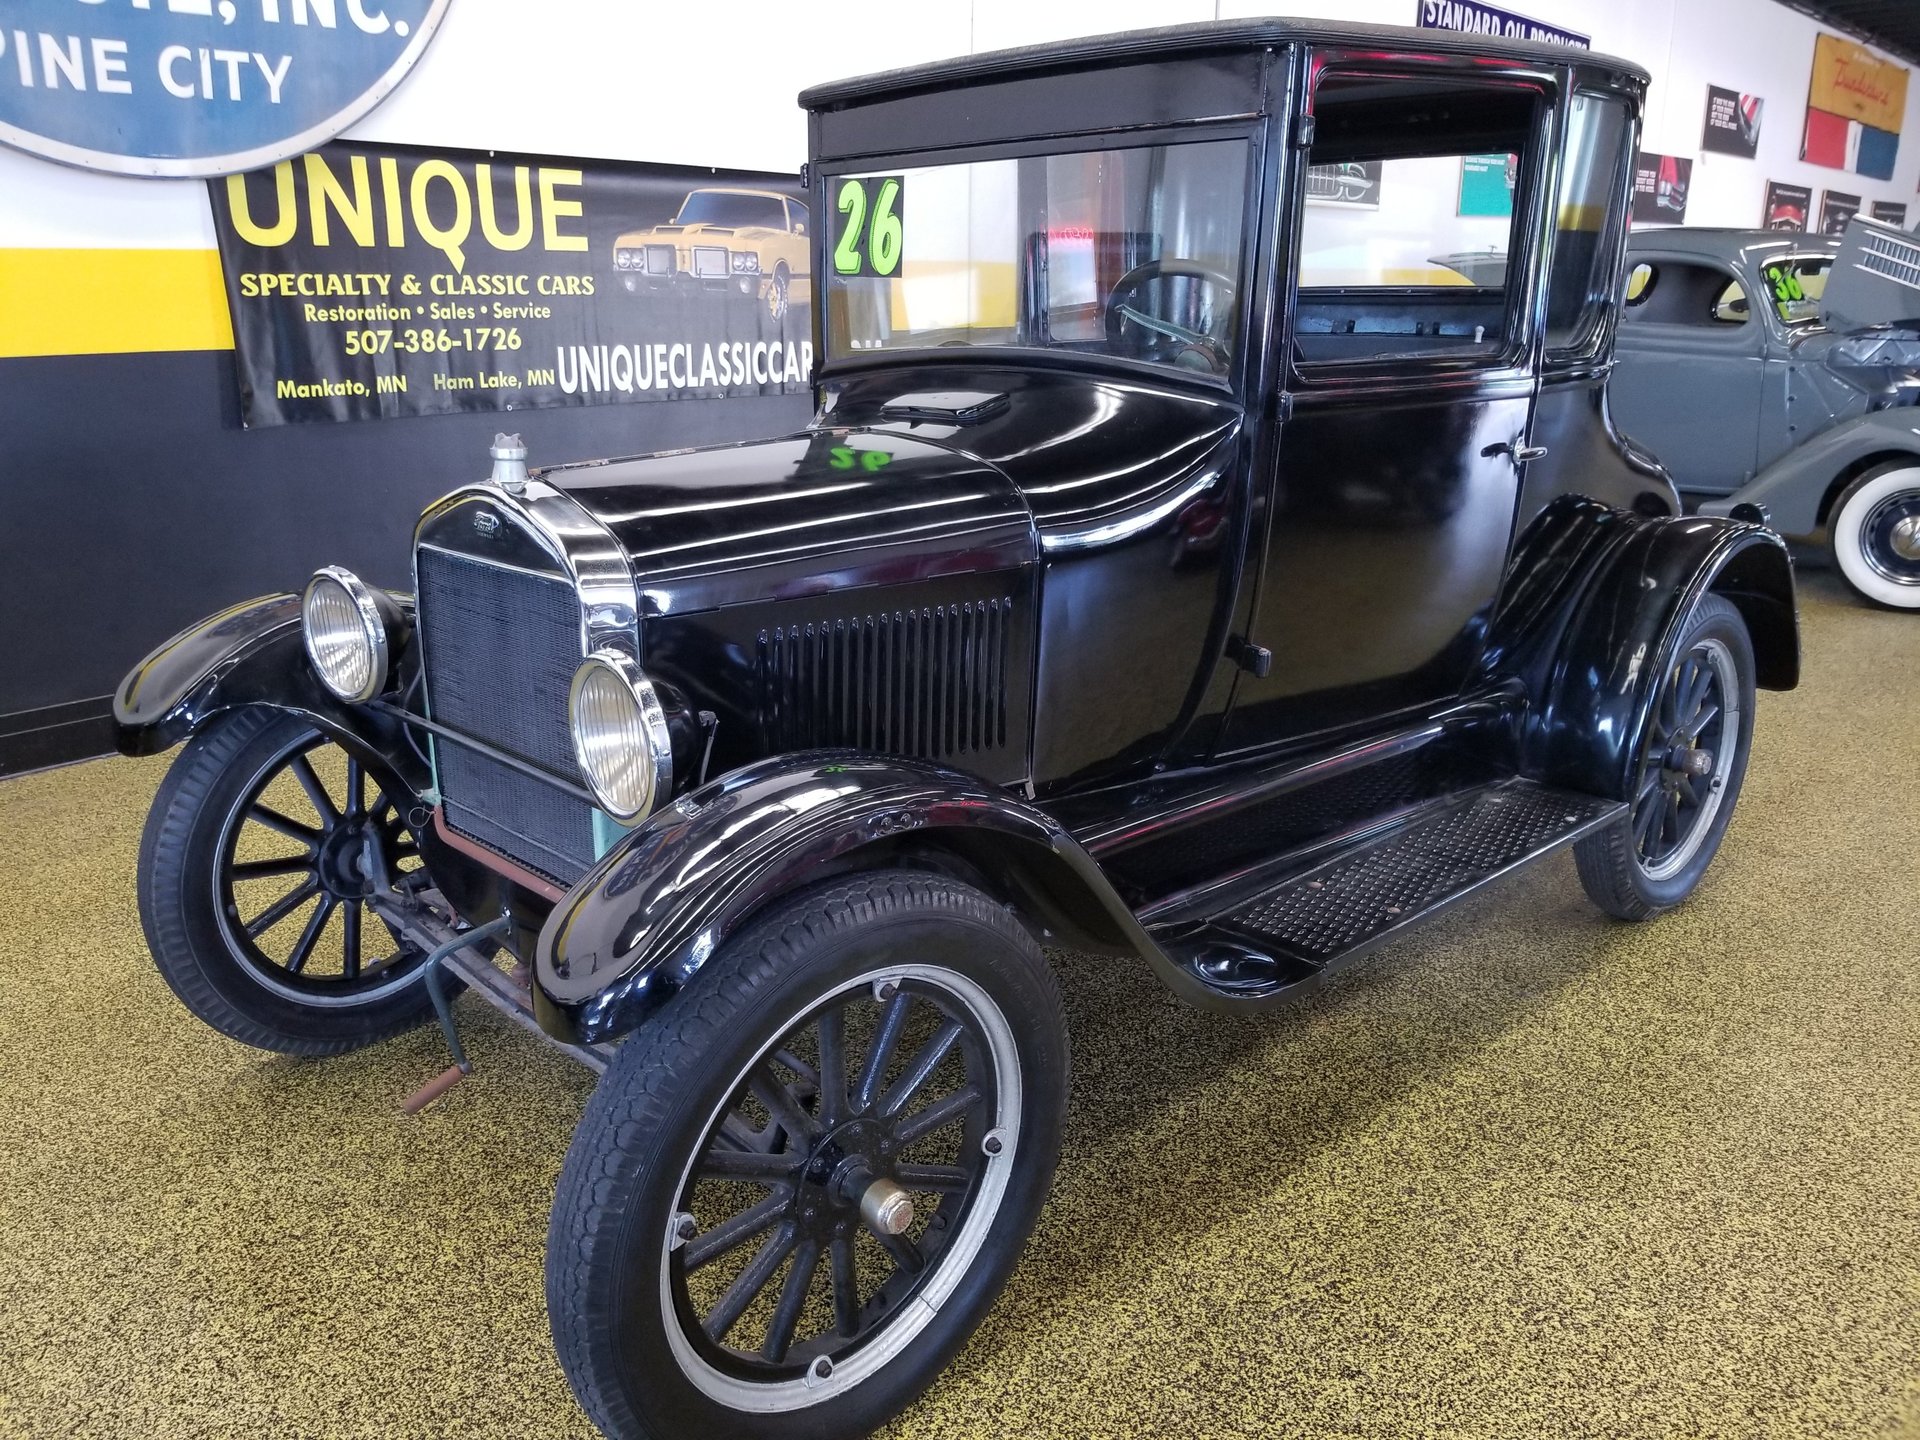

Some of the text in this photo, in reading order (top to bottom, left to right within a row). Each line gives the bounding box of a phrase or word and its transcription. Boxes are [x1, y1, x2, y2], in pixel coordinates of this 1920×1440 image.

[1427, 0, 1500, 37] STANDARD
[1530, 27, 1588, 50] PROD
[0, 28, 292, 103] INE CITY
[226, 153, 589, 274] UNIQUE
[834, 179, 903, 276] 26
[240, 273, 595, 297] SPECIALTY & CLASSIC CARS
[304, 302, 551, 322] Restoration Sales Service
[345, 327, 522, 356] 507-386-1726
[276, 375, 408, 399] Mankato, MN
[433, 369, 555, 391] Ham Lake, MN
